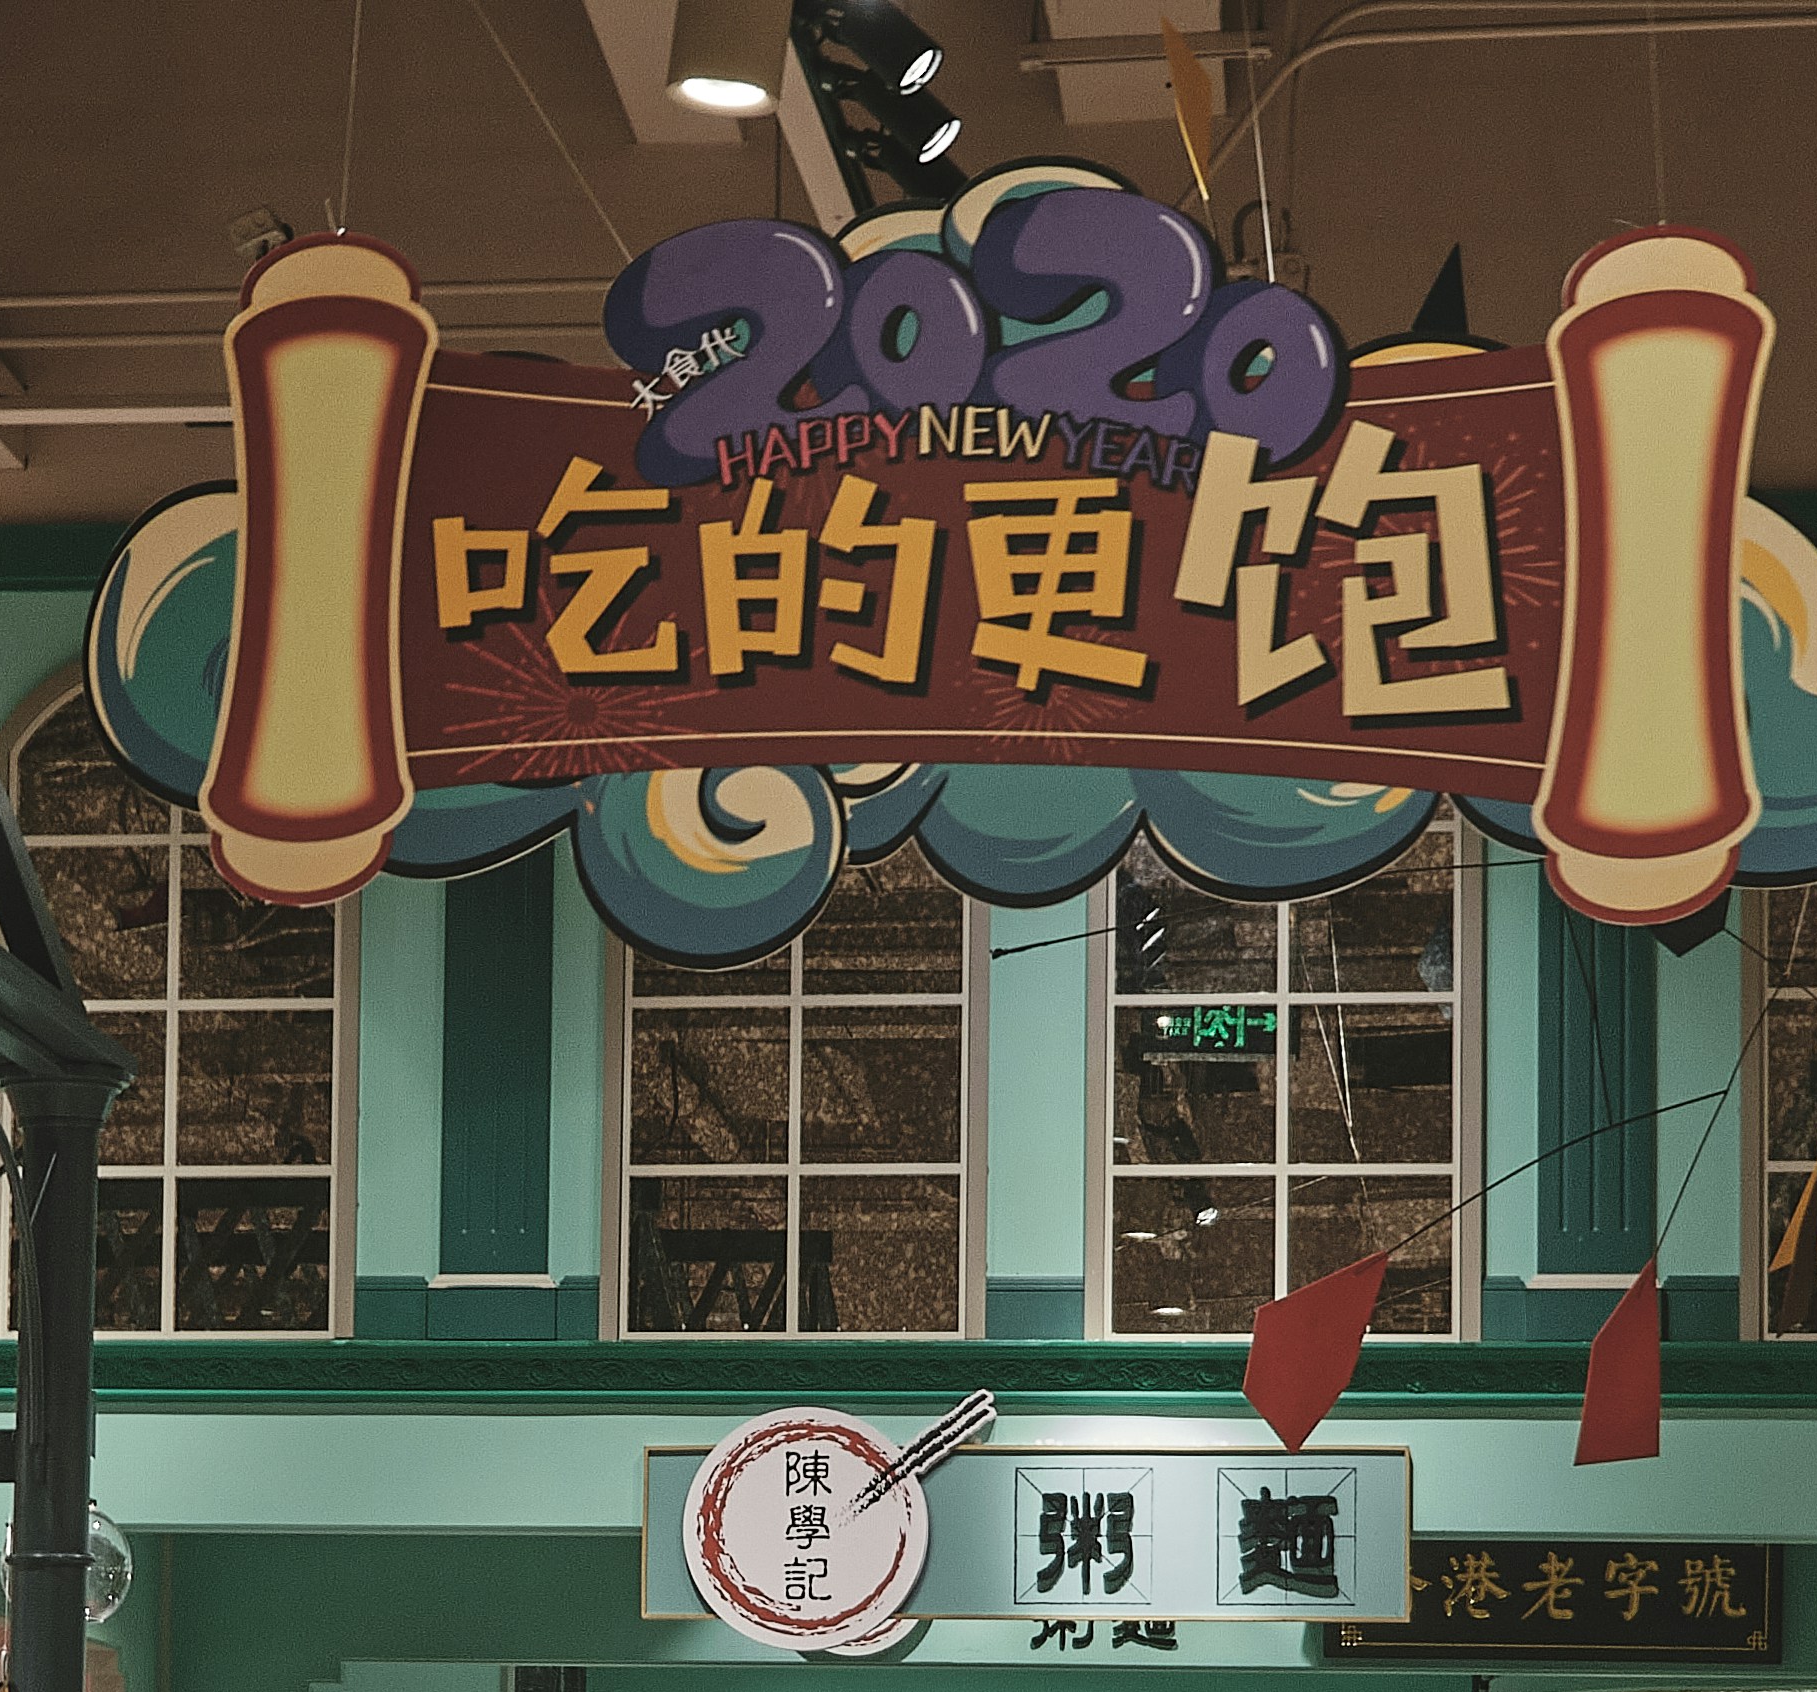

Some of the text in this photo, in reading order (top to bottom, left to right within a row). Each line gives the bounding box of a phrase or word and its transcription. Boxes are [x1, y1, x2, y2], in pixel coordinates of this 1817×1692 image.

[604, 184, 1348, 486] 2020
[630, 327, 746, 422] 大食代
[716, 404, 1204, 490] HAPPY NEW YEAR
[432, 420, 1514, 716] 吃的更饱
[783, 1450, 832, 1601] 陳學記
[1410, 1551, 1748, 1620] 港老字號
